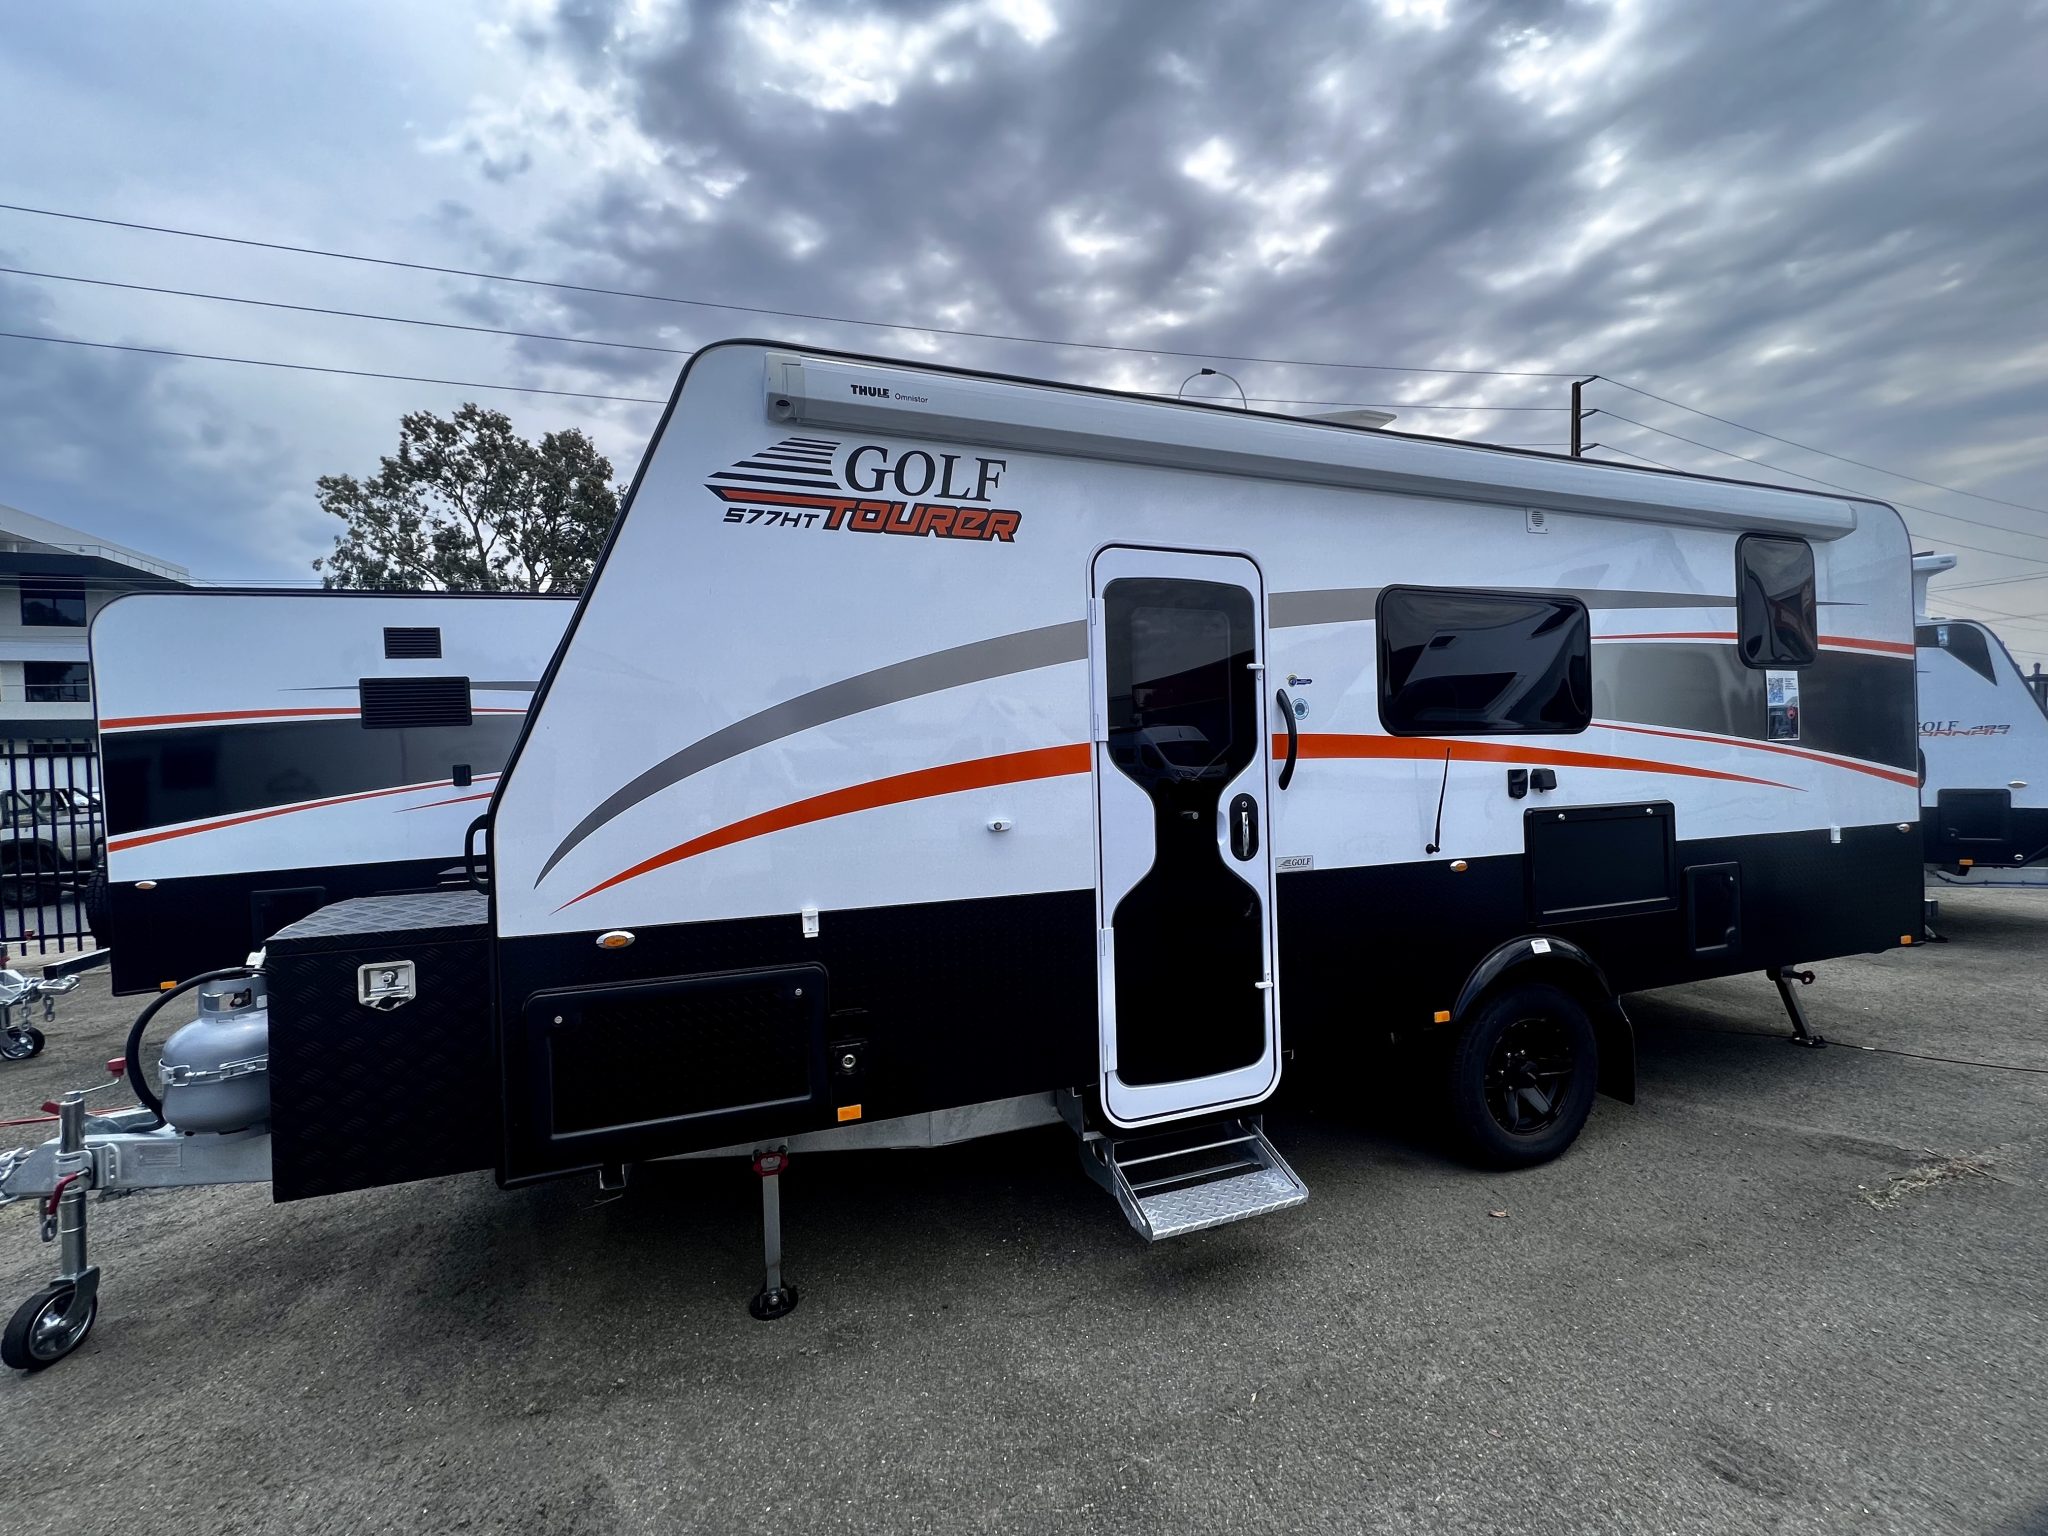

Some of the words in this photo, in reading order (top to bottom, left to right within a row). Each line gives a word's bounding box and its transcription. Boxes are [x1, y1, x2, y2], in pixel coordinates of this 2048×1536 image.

[850, 384, 890, 399] THULE
[894, 392, 929, 404] Omnistor
[845, 445, 1007, 502] GOLF
[723, 507, 820, 529] 577HT
[822, 501, 1022, 543] TOURER
[1918, 720, 1960, 733] OLF
[1291, 857, 1312, 867] GOLF
